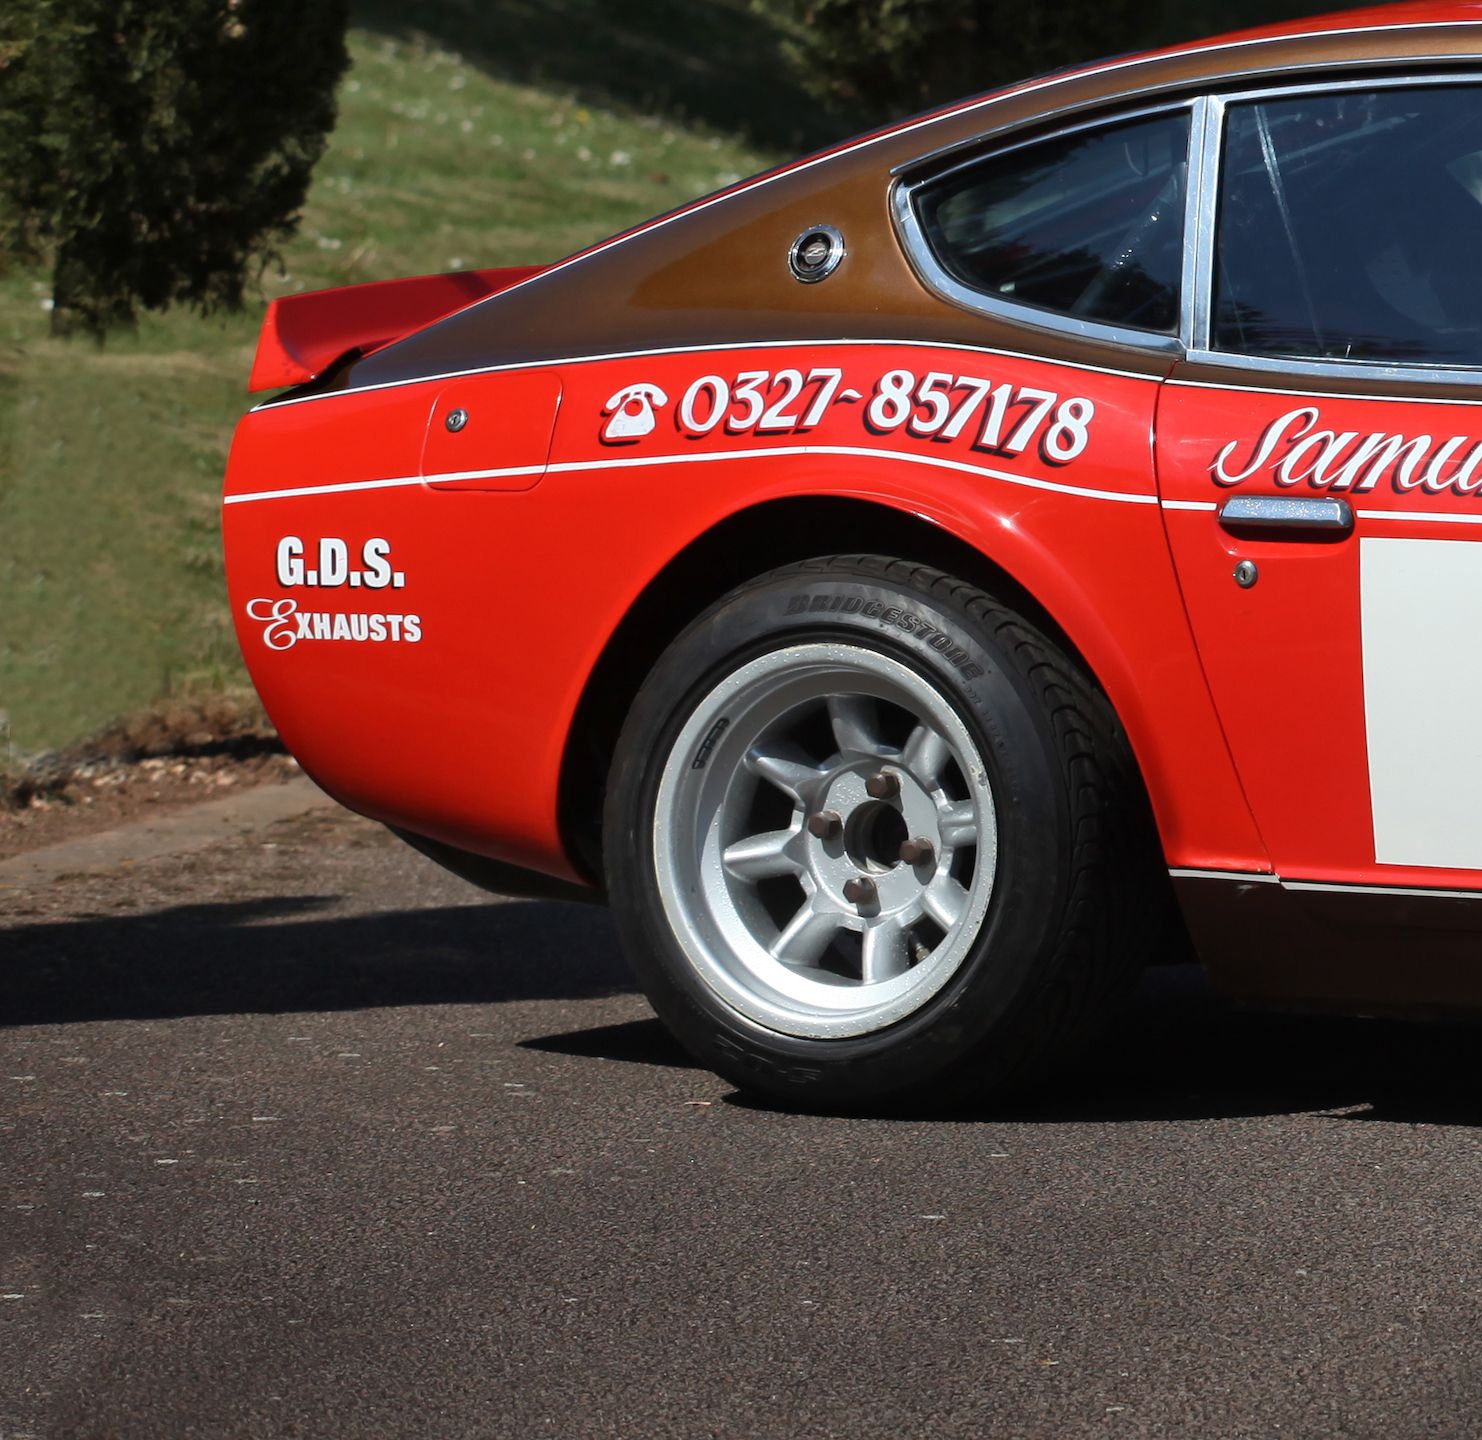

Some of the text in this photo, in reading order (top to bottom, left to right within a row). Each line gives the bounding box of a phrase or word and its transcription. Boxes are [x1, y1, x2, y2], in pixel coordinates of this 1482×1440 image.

[277, 536, 405, 589] G.D.S.
[246, 598, 422, 650] EXHAUSTS
[783, 594, 986, 682] BRIDGESTONE
